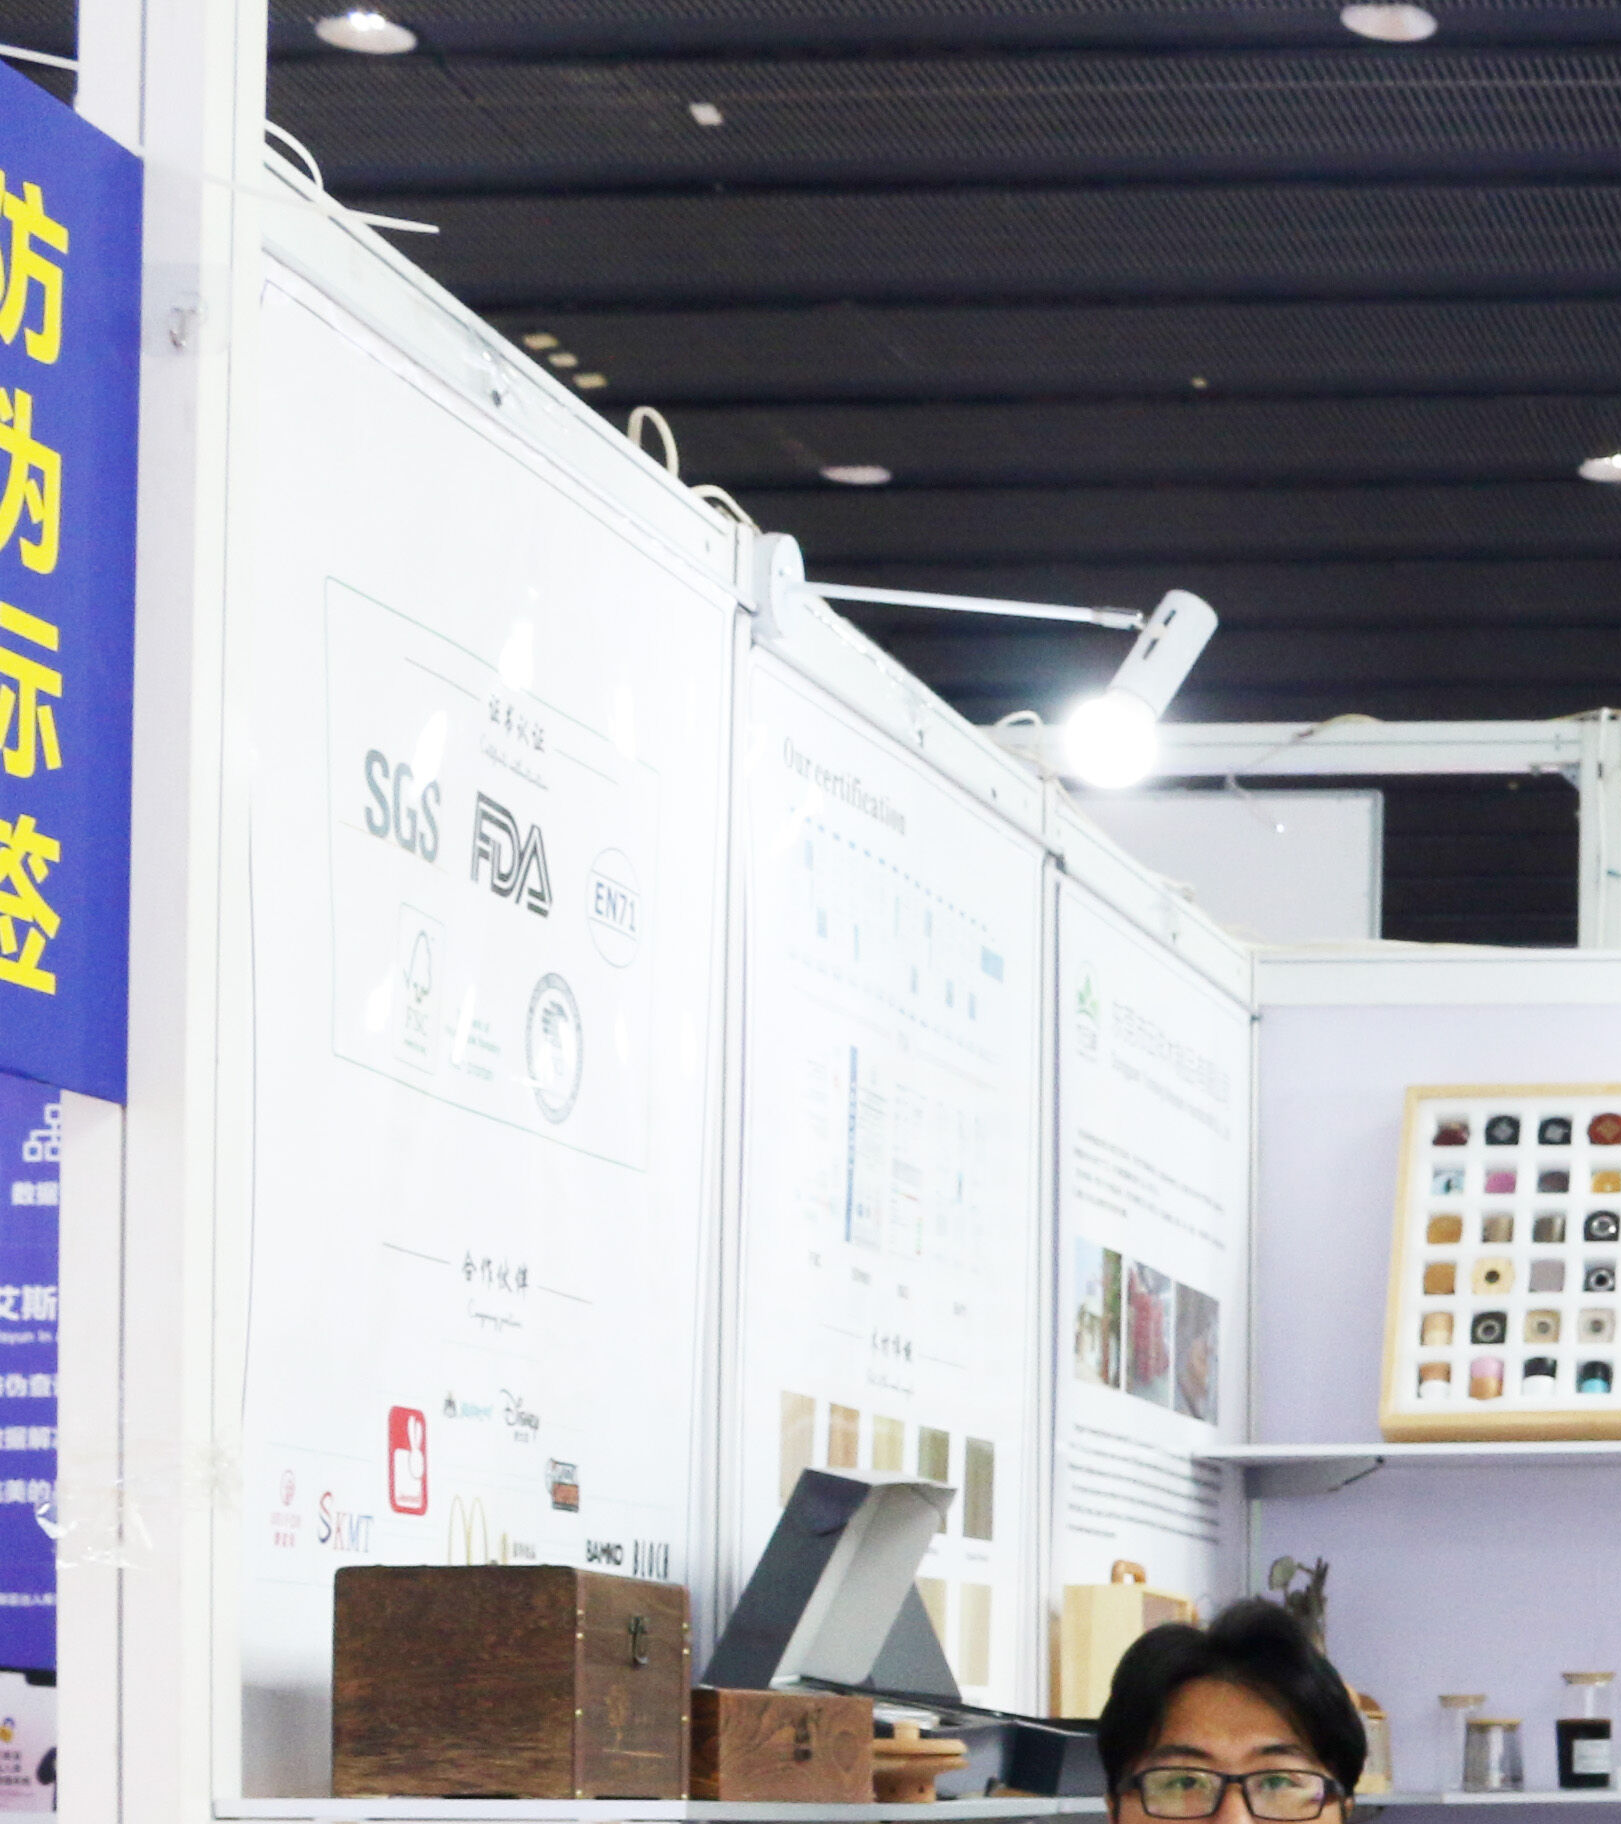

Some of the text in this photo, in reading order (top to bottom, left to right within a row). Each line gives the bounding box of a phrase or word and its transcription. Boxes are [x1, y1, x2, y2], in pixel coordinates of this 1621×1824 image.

[364, 748, 440, 864] SGS
[470, 791, 553, 919] FDA
[593, 880, 637, 933] EN71
